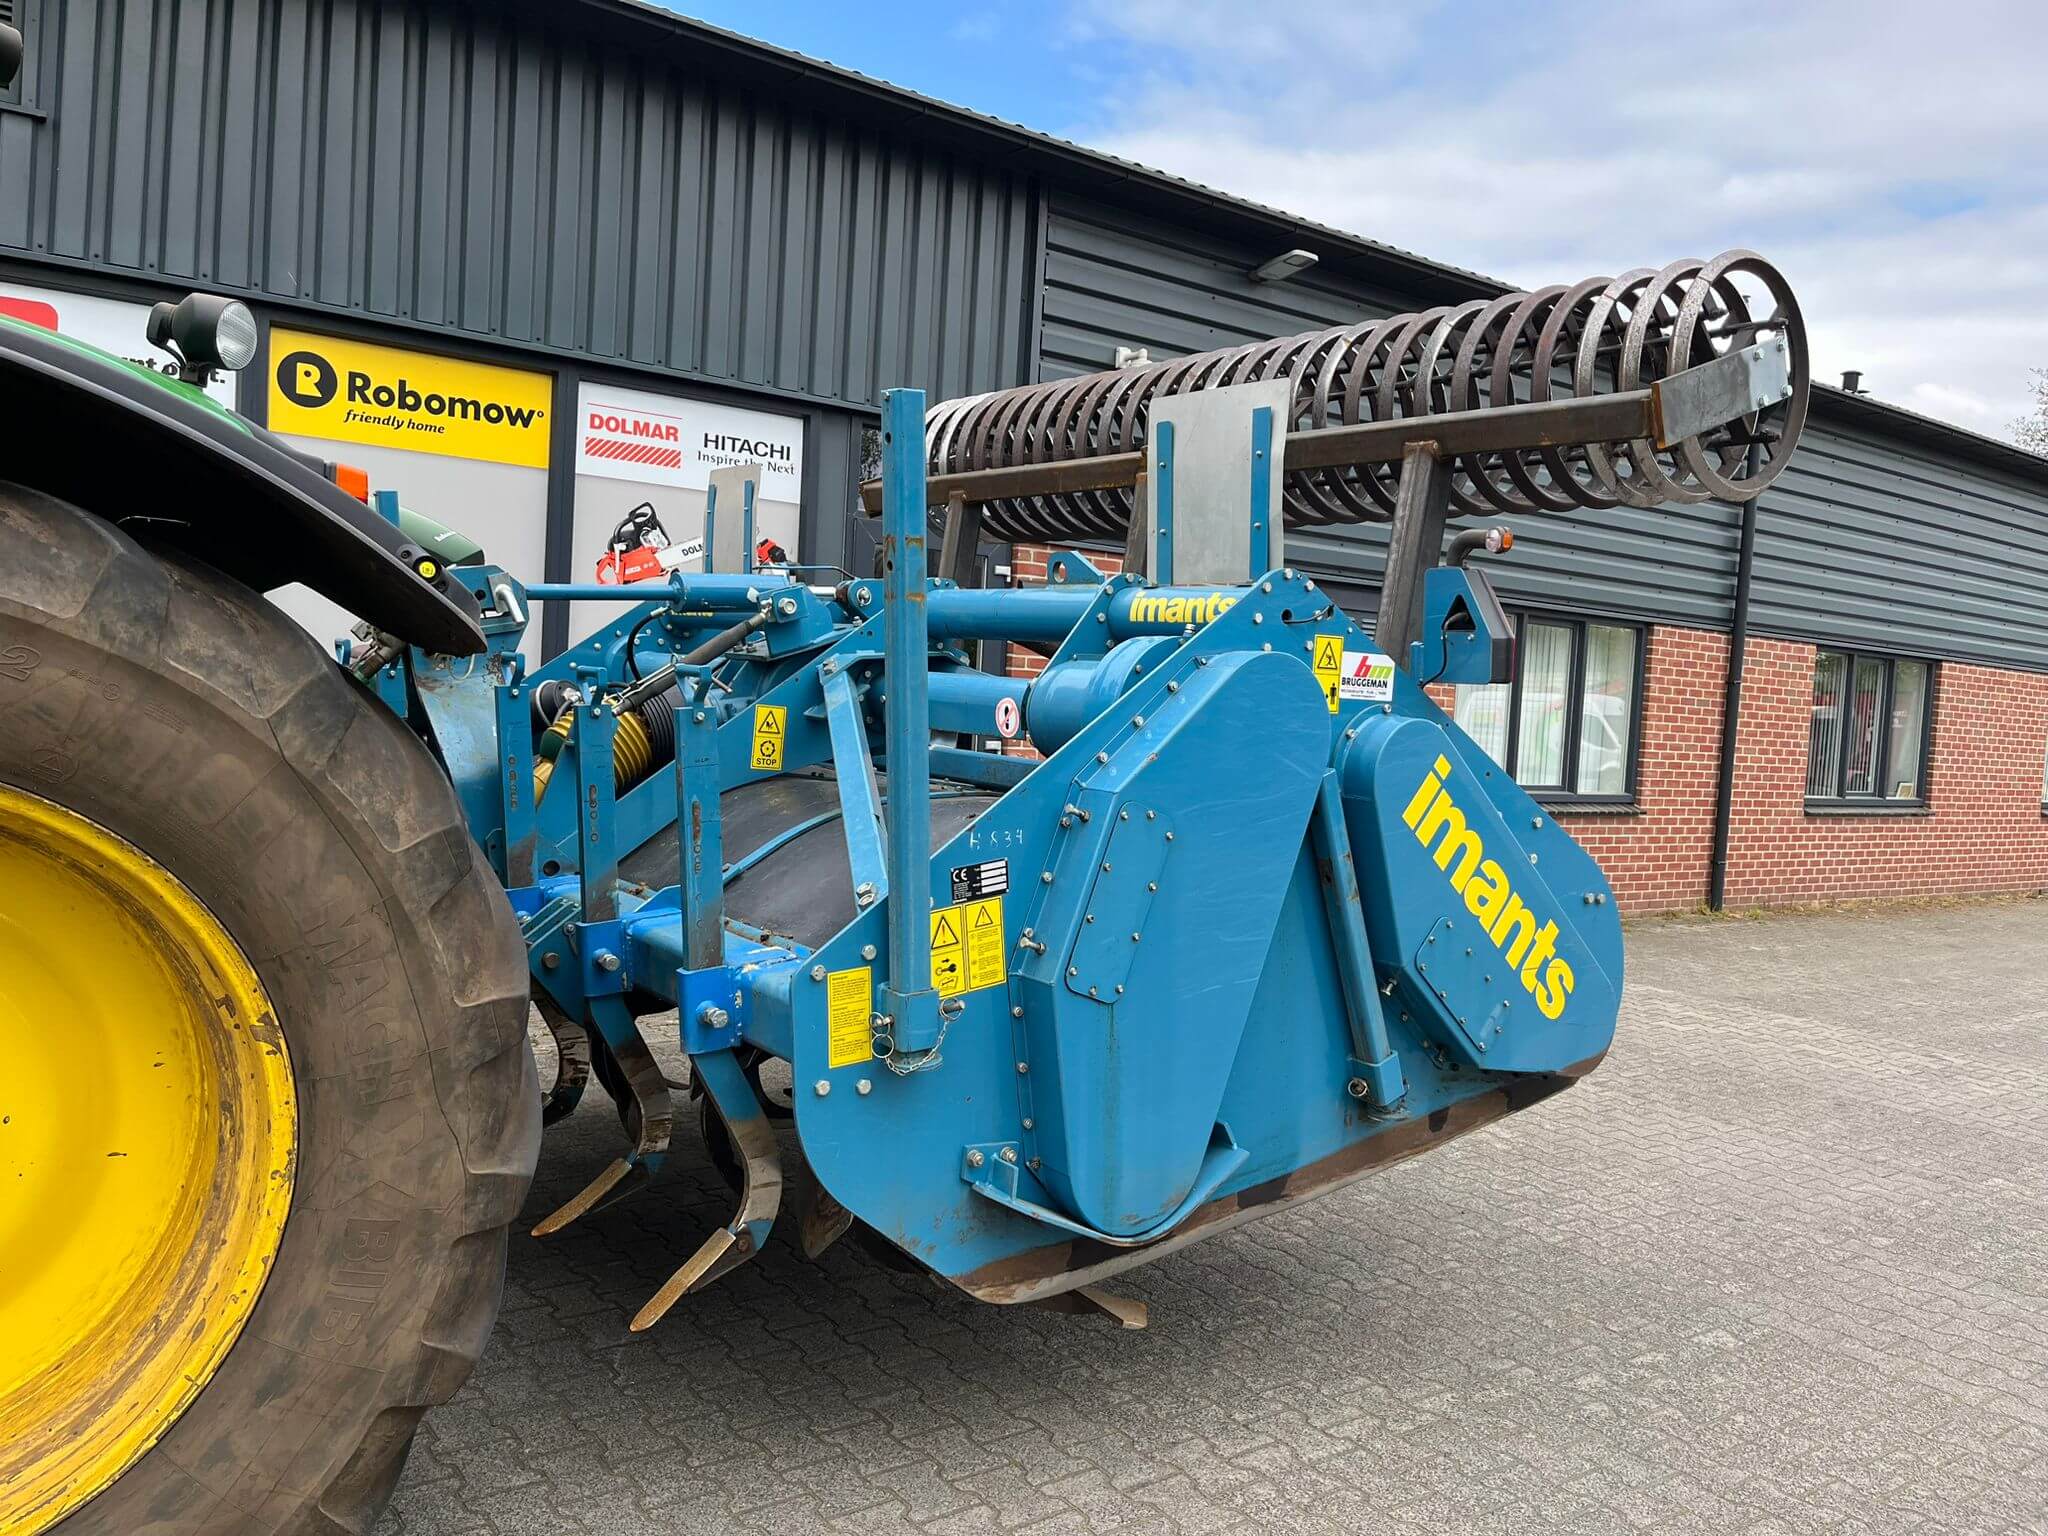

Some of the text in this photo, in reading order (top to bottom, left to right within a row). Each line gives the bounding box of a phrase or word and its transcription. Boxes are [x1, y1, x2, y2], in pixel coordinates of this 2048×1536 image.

[343, 409, 446, 435] friendly home
[589, 413, 680, 442] DOLMAR
[703, 432, 791, 461] HITACHI
[697, 451, 741, 468] Inspire
[767, 462, 795, 476] Next
[1341, 676, 1388, 689] BRUGGEMAN
[756, 757, 777, 767] STOP
[1401, 753, 1575, 1020] imants
